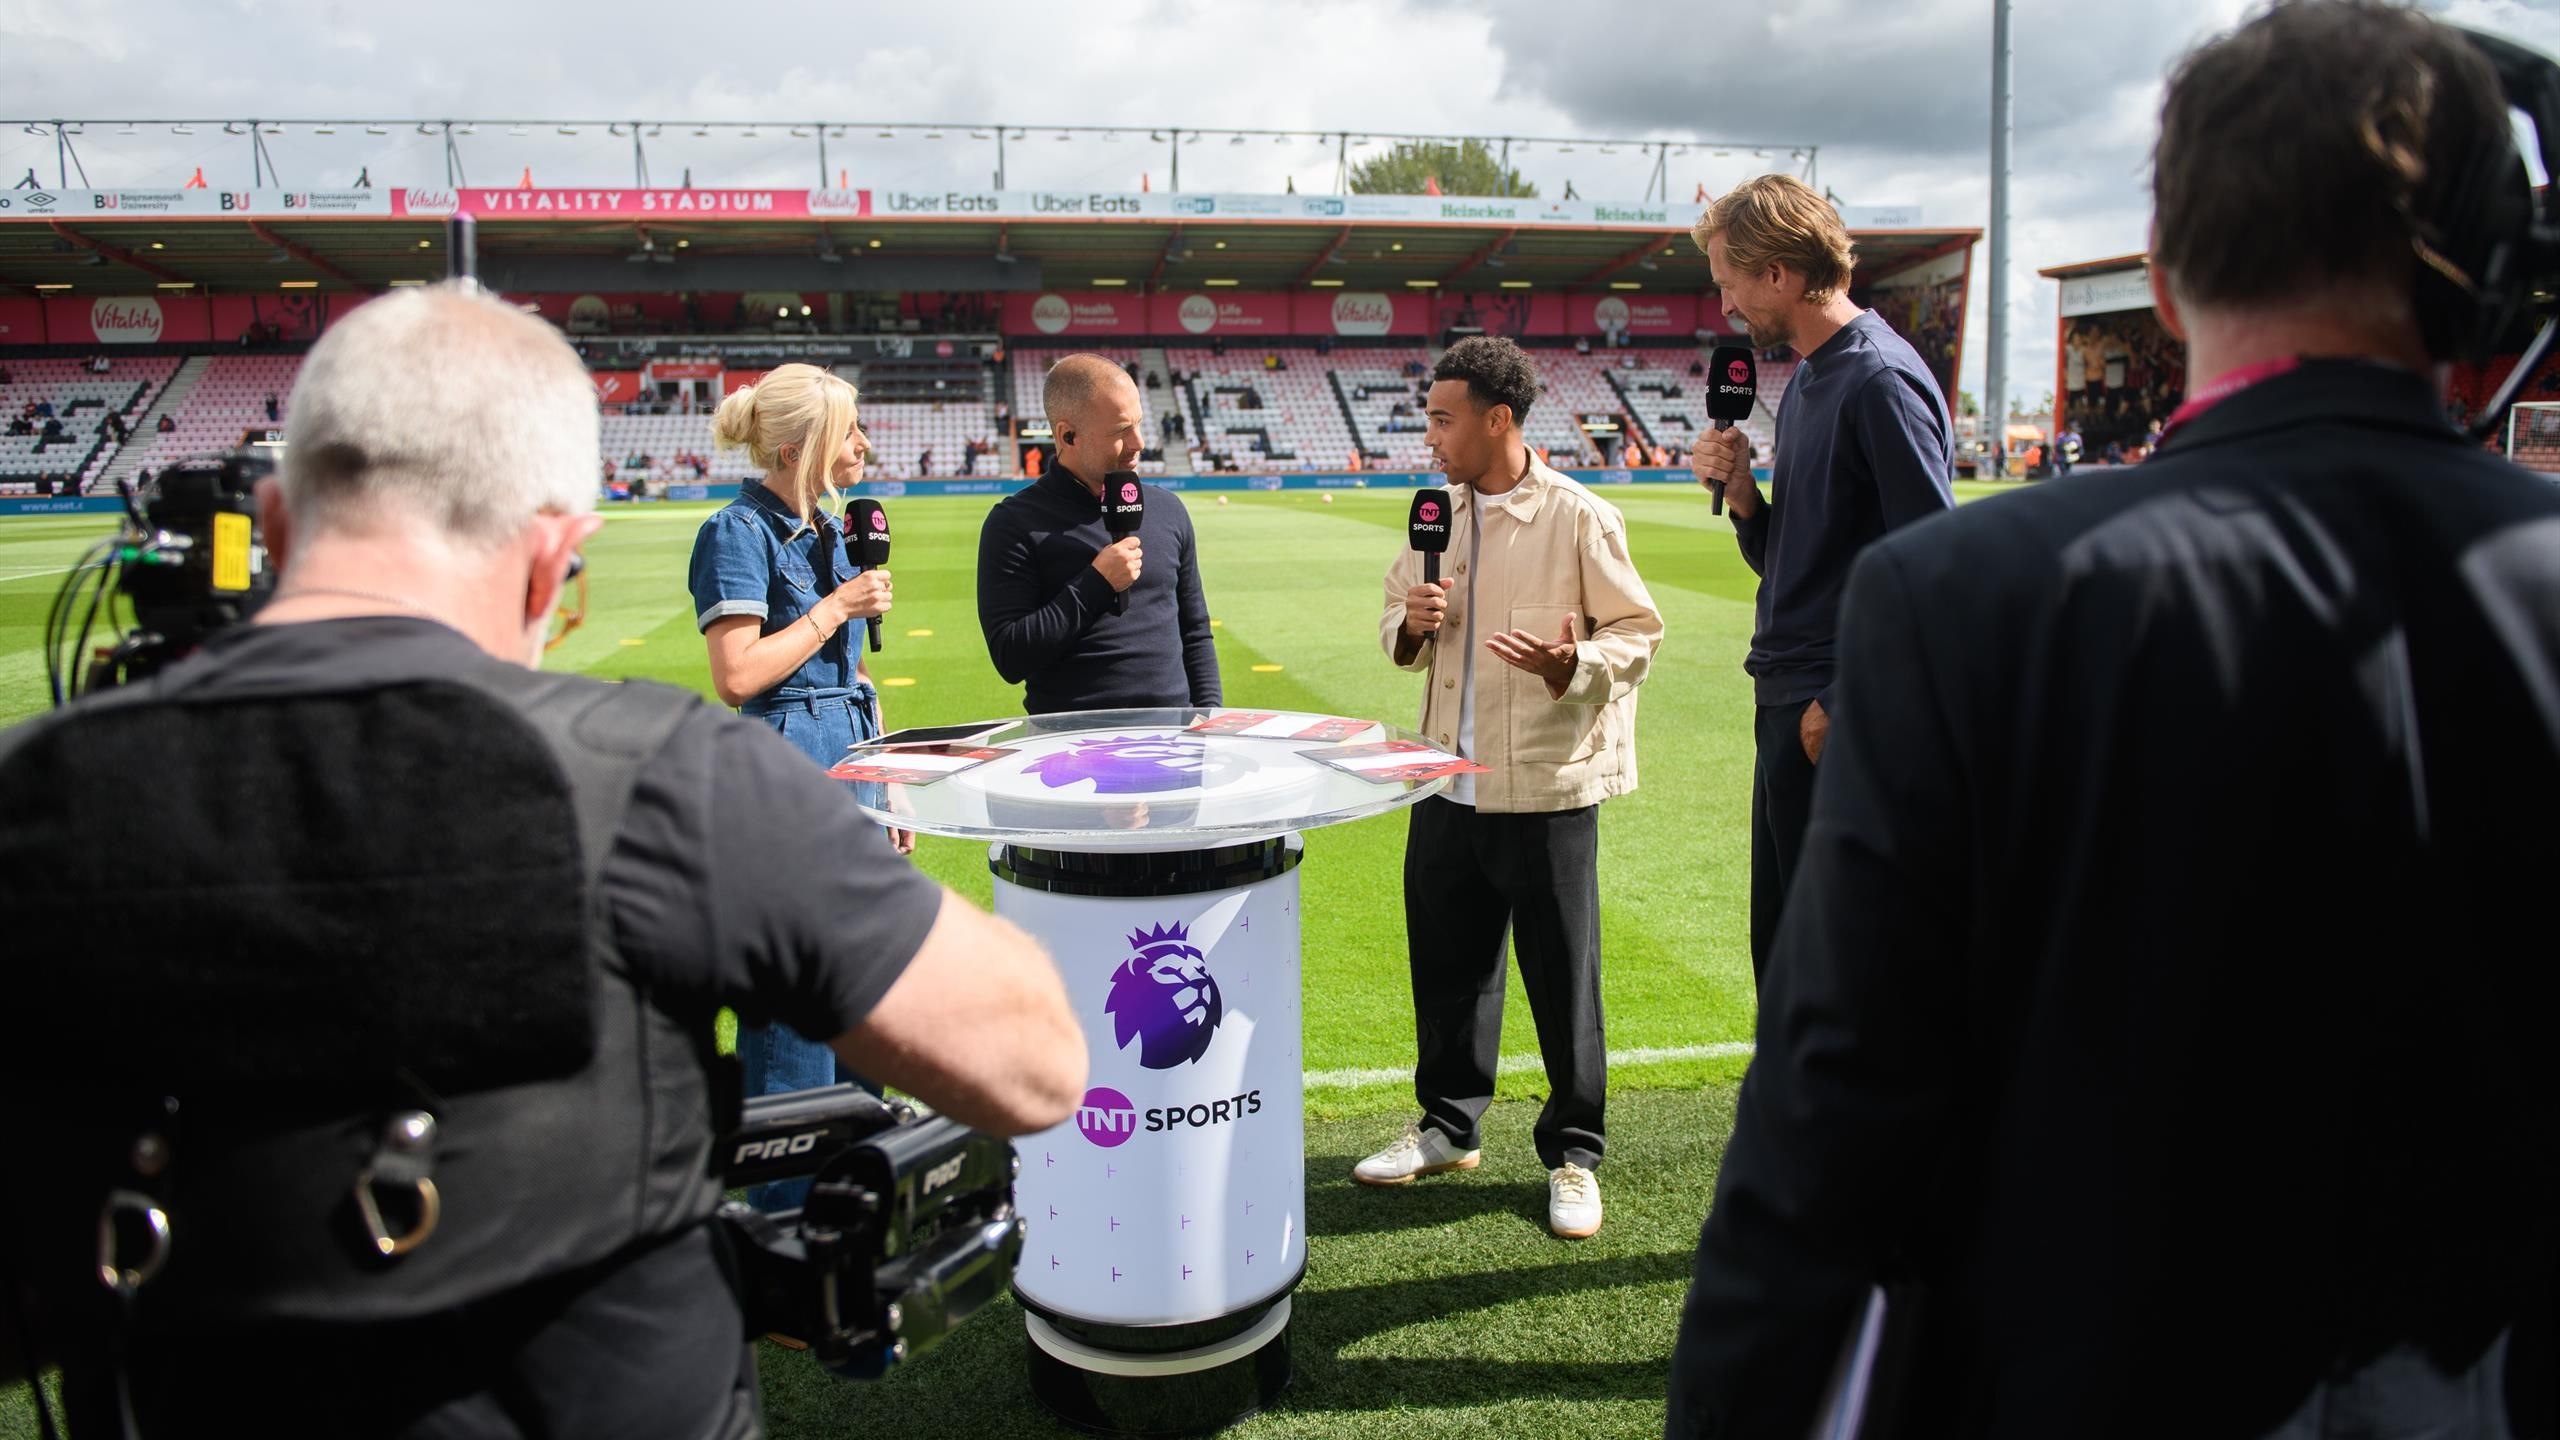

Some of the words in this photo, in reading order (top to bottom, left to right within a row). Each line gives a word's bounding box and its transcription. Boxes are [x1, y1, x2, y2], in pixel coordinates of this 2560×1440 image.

[94, 194, 118, 209] BU
[121, 202, 169, 211] University
[221, 193, 250, 210] BU
[284, 193, 307, 208] BU
[408, 189, 457, 210] Vitality
[483, 192, 622, 210] VITALITY
[642, 192, 774, 211] STADIUM
[887, 193, 940, 212] Uber
[946, 194, 999, 213] Eats
[1032, 194, 1083, 213] Uber
[1089, 195, 1141, 213] Eats
[1441, 204, 1515, 218] Heineken
[1595, 207, 1667, 222] Heineken
[1073, 304, 1114, 315] Health
[1219, 304, 1242, 316] Life
[1335, 300, 1391, 329] Vitality
[94, 304, 160, 335] Vitality
[1719, 385, 1753, 396] SPORTS
[1117, 504, 1143, 513] SPORTS
[1412, 523, 1445, 533] SPORTS
[868, 532, 890, 542] SPORTS
[1076, 1105, 1137, 1133] TNT
[1145, 1090, 1262, 1132] SPORTS
[733, 1133, 817, 1165] PRO
[922, 1157, 962, 1195] PRO
